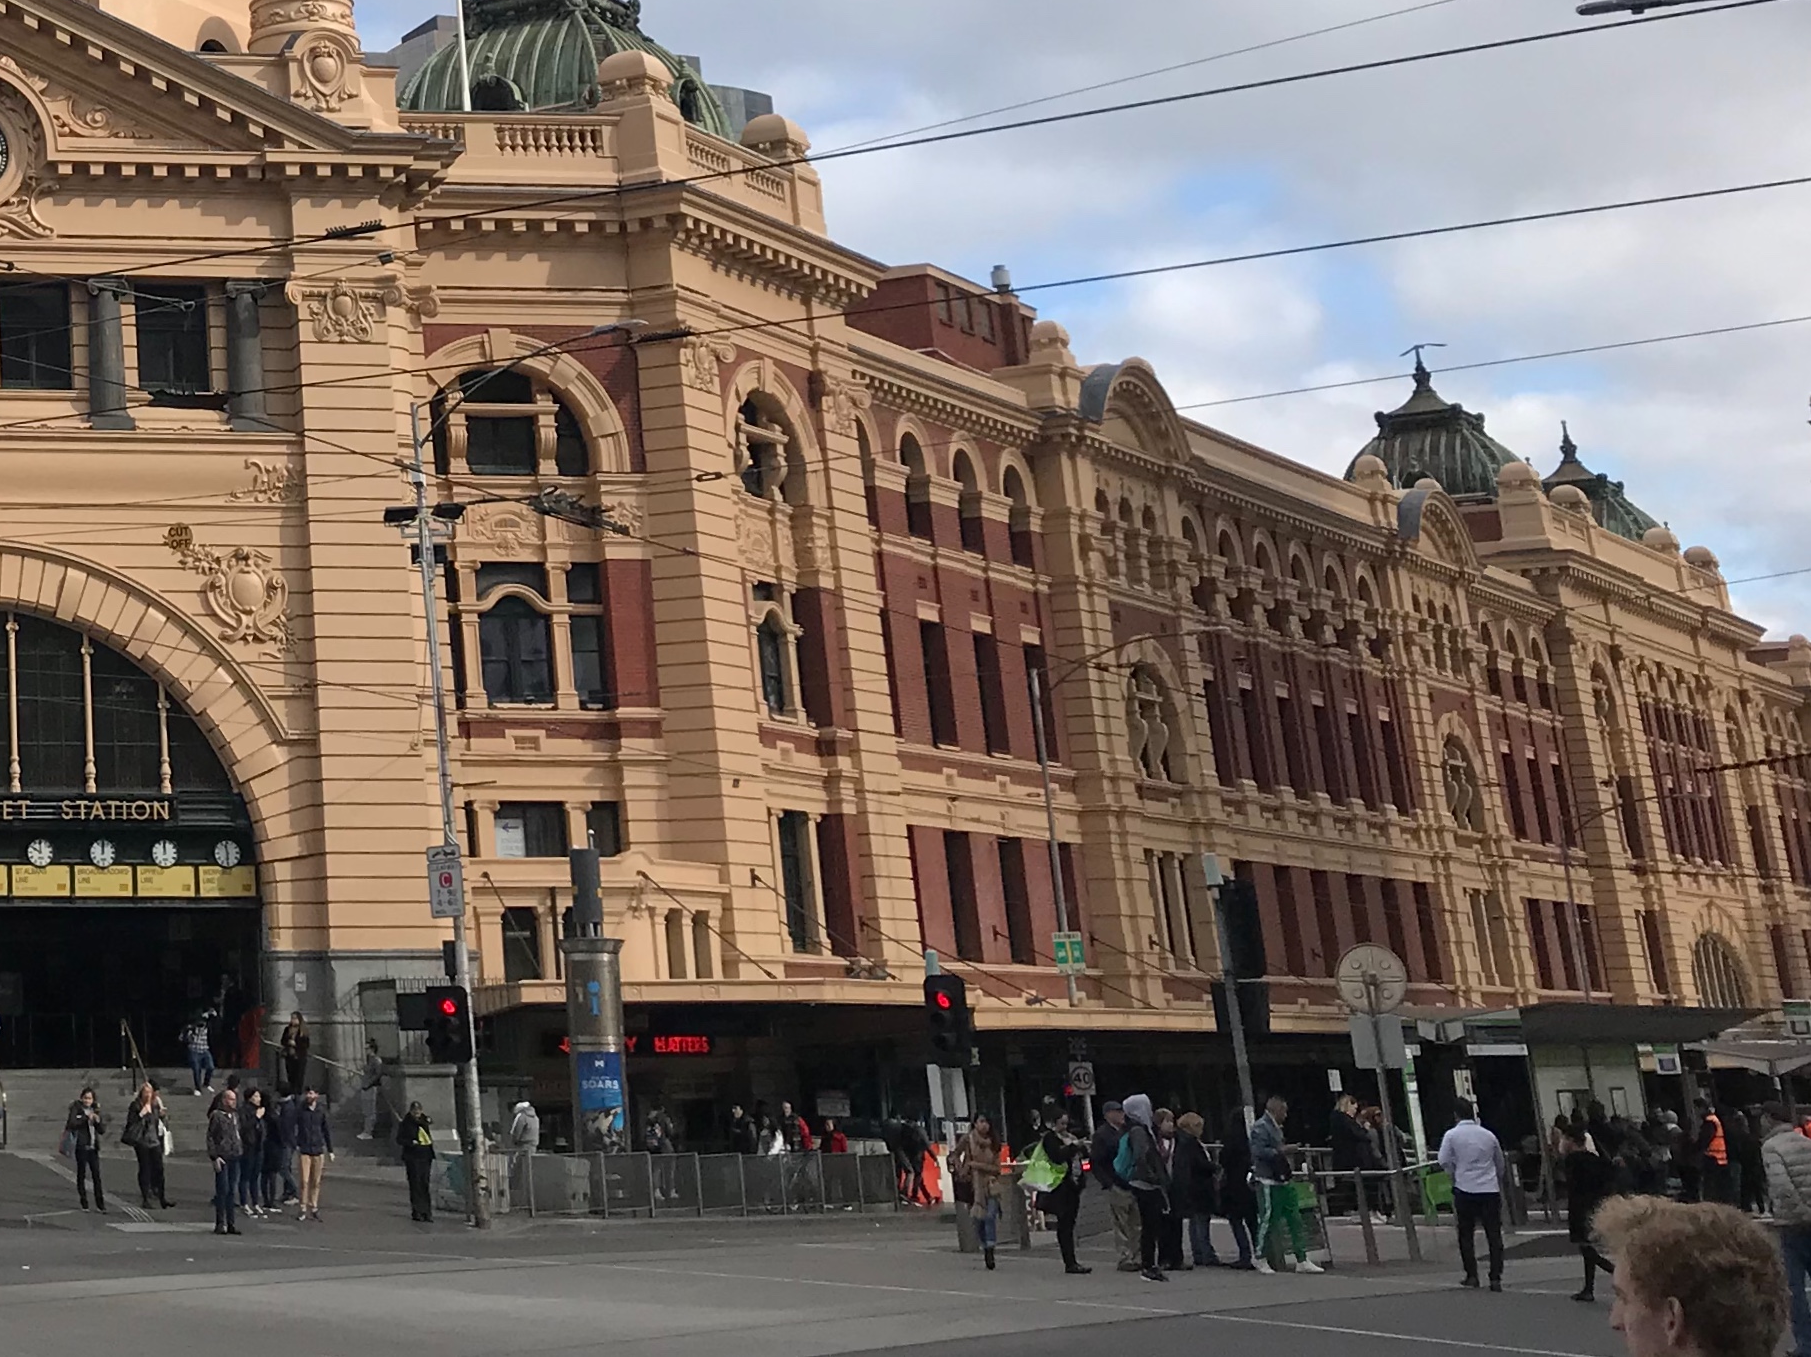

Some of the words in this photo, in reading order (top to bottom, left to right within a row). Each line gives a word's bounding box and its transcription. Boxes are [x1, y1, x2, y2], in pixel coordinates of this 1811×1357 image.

[168, 527, 189, 537] CUT
[171, 539, 191, 550] OFF
[61, 800, 169, 820] STATION
[1074, 1072, 1090, 1084] 40
[582, 1080, 619, 1090] SOARS
